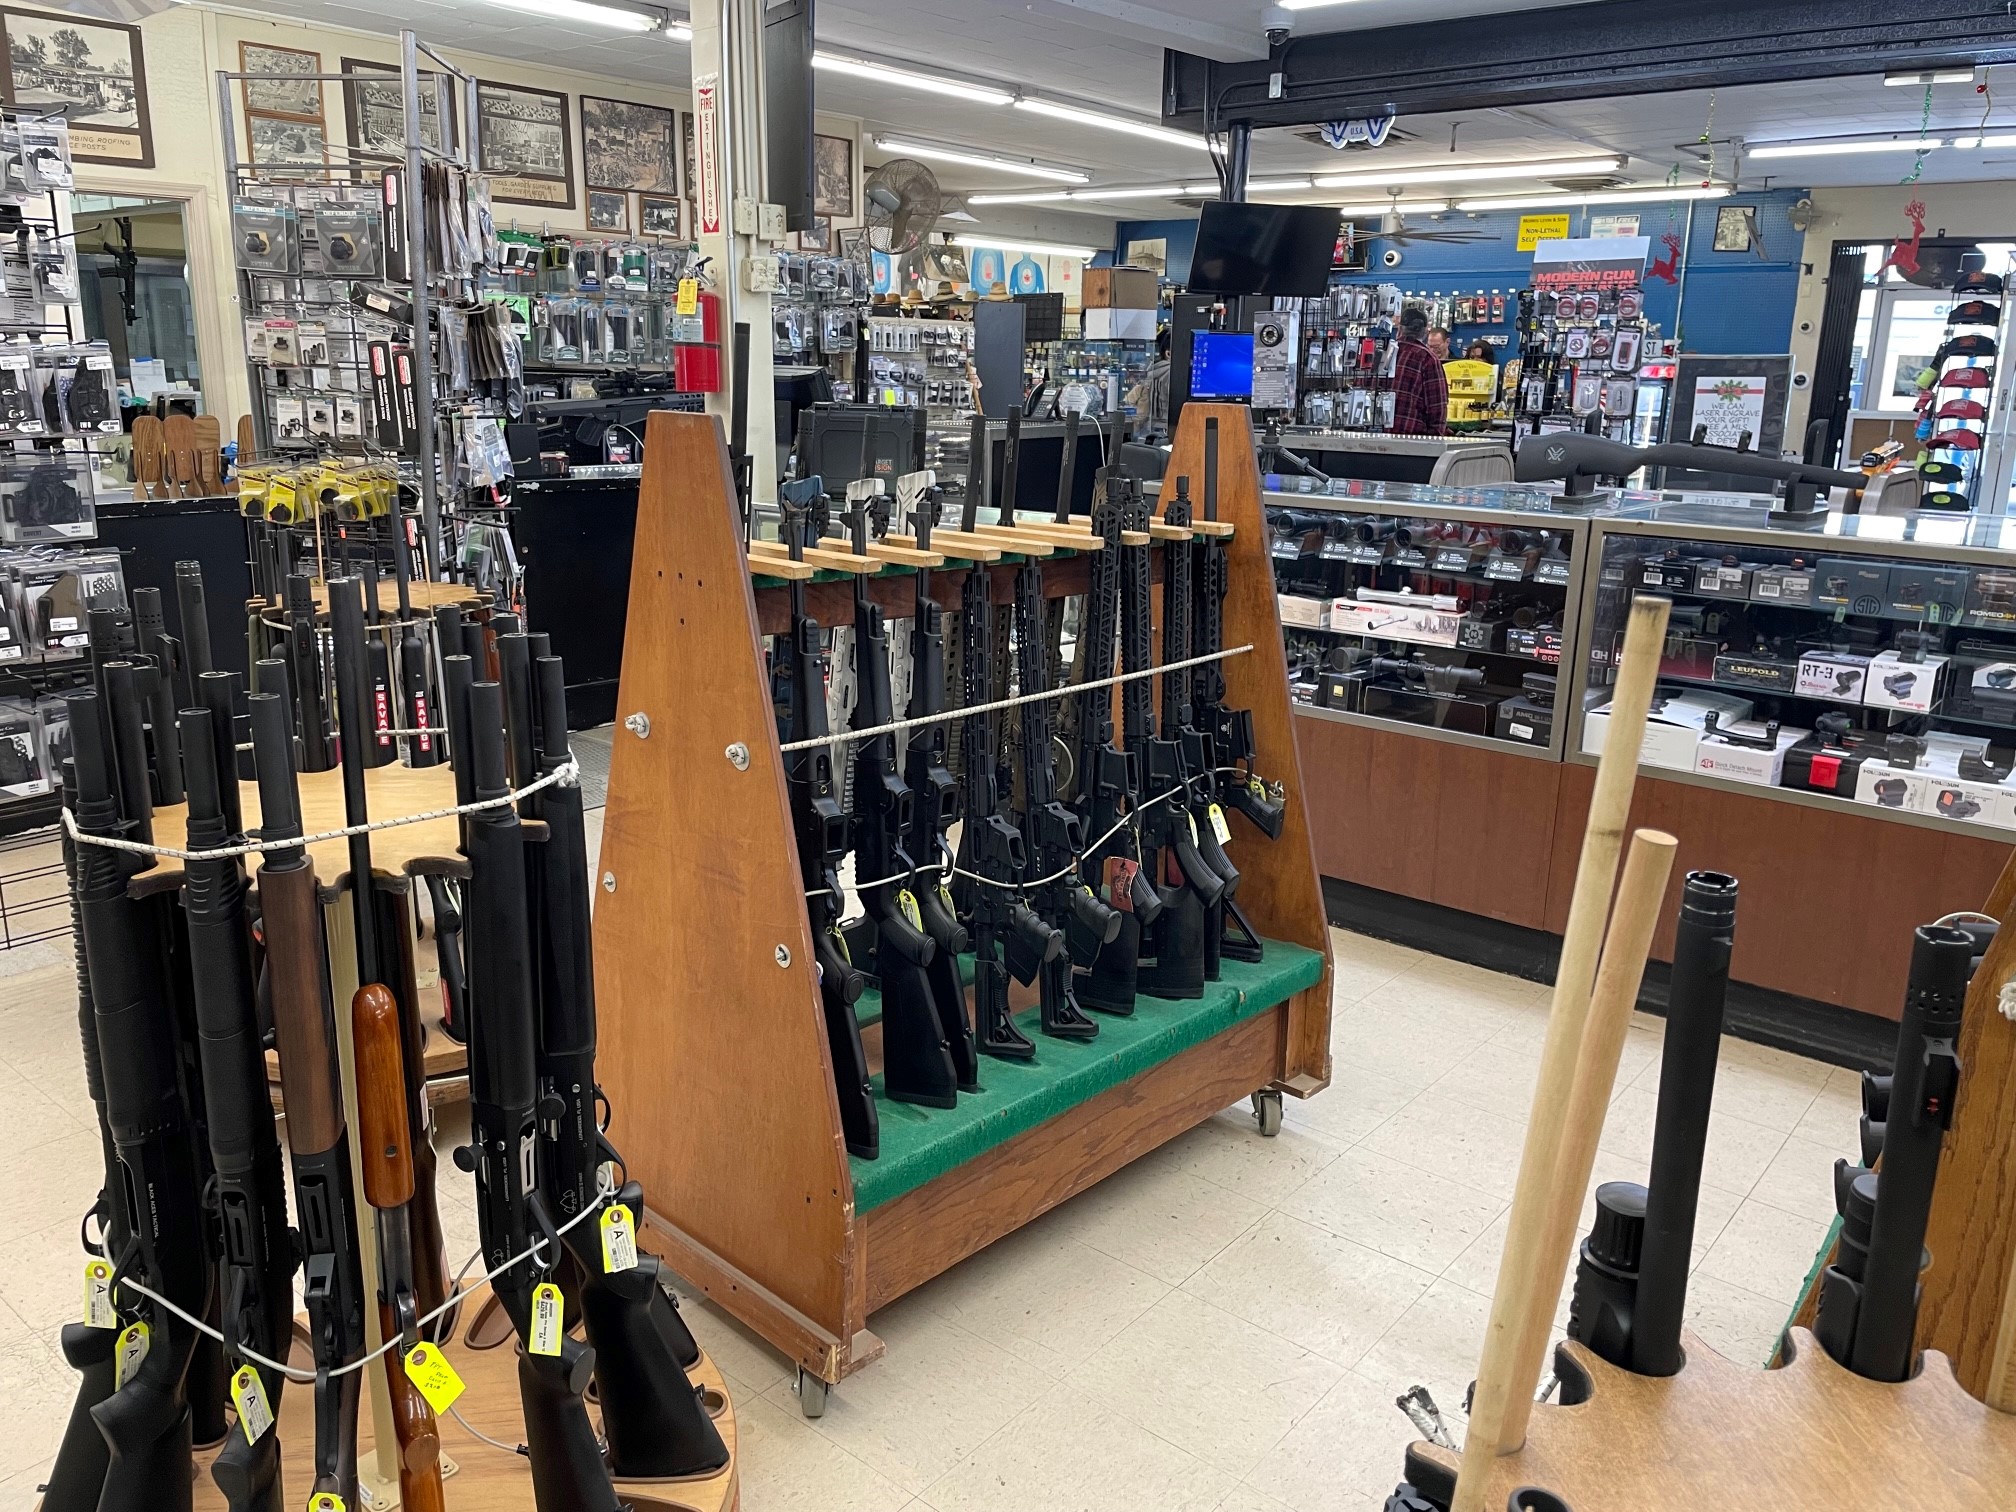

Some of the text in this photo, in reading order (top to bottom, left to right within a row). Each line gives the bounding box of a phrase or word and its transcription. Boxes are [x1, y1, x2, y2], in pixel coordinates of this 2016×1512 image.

[81, 143, 107, 151] POSTS
[96, 137, 131, 146] ROOFING
[703, 113, 714, 226] EXTINGUISHER
[1536, 270, 1636, 283] MODERN GUN
[1857, 599, 1878, 614] SIG
[1730, 665, 1780, 676] LEUPOLD
[1802, 664, 1834, 679] RT-3
[377, 693, 389, 744] SAVAE
[613, 1230, 624, 1240] A
[96, 1283, 106, 1293] A
[129, 1349, 138, 1359] A
[247, 1395, 256, 1407] A
